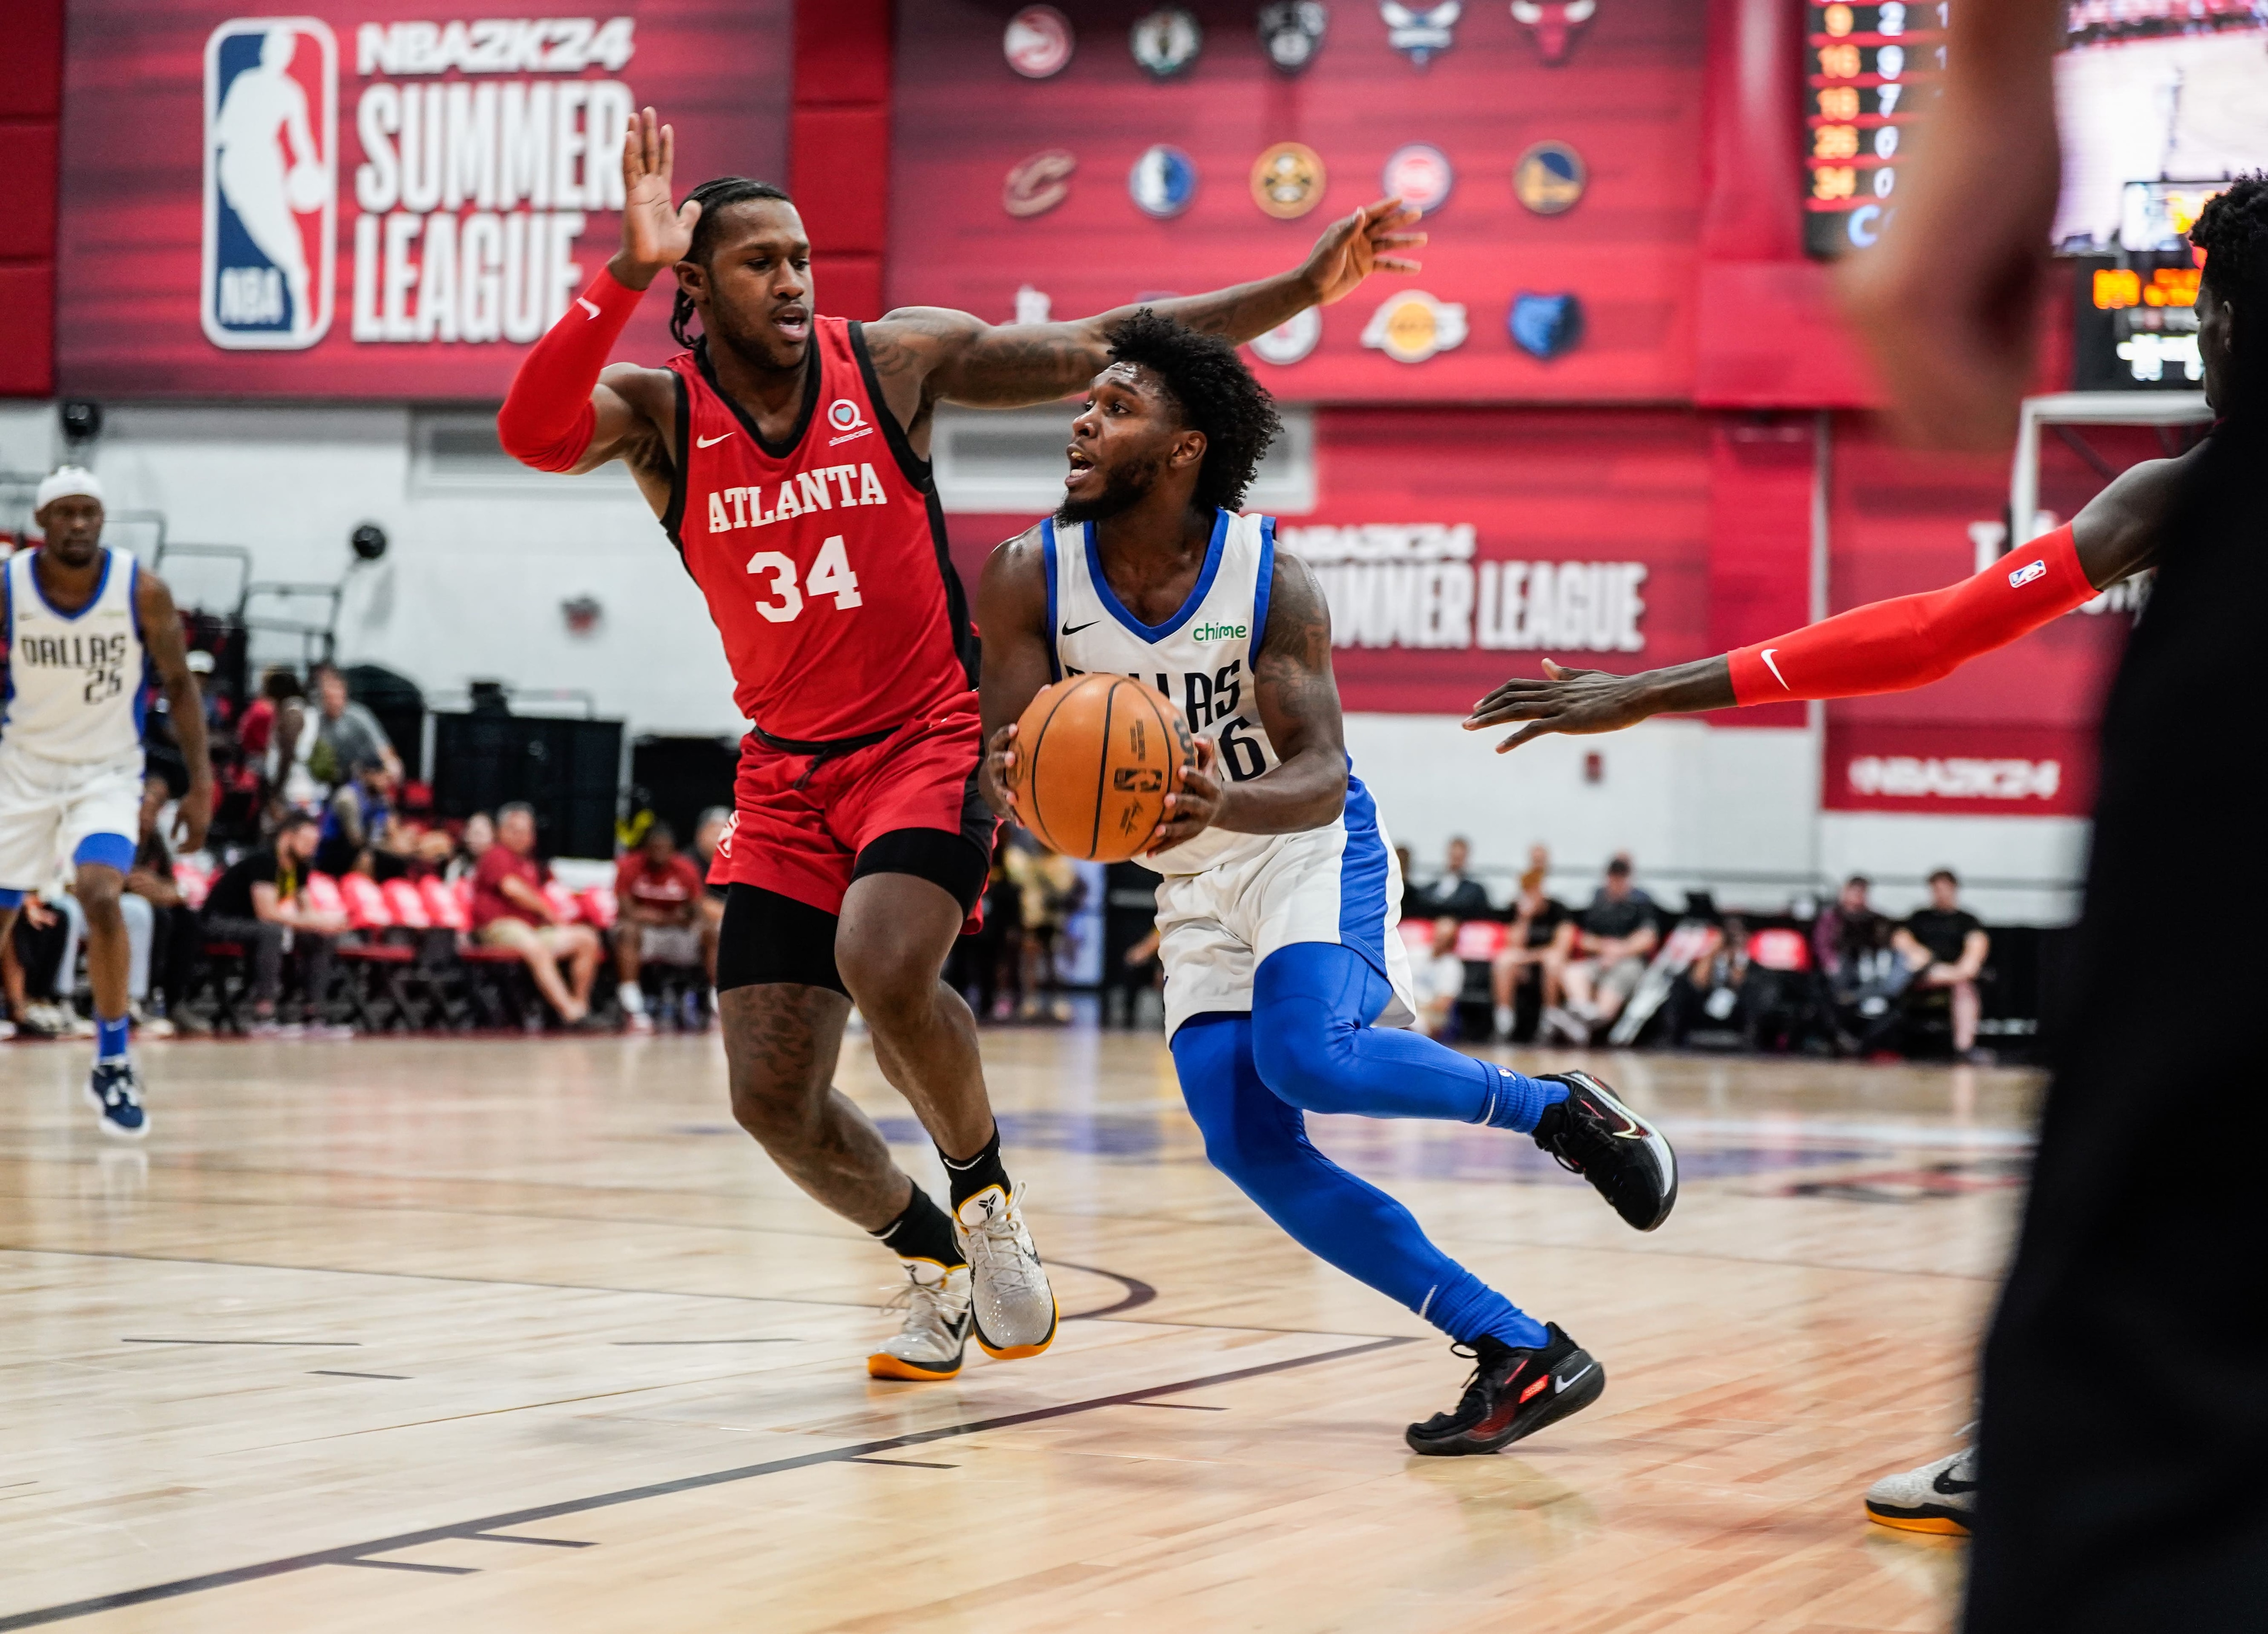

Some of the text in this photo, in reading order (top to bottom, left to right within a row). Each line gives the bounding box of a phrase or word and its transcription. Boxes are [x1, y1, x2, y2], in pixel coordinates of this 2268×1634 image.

[357, 17, 636, 74] NBA2K24
[356, 81, 634, 213] SUMMER
[220, 267, 284, 325] NBA
[352, 212, 586, 343] LEAGUE
[709, 463, 888, 534] ATLANTA
[746, 535, 863, 623] 34
[1313, 561, 1647, 652] MMER LEAGUE
[21, 633, 126, 668] DALLAS
[1193, 622, 1247, 641] chime
[1218, 717, 1266, 781] 6
